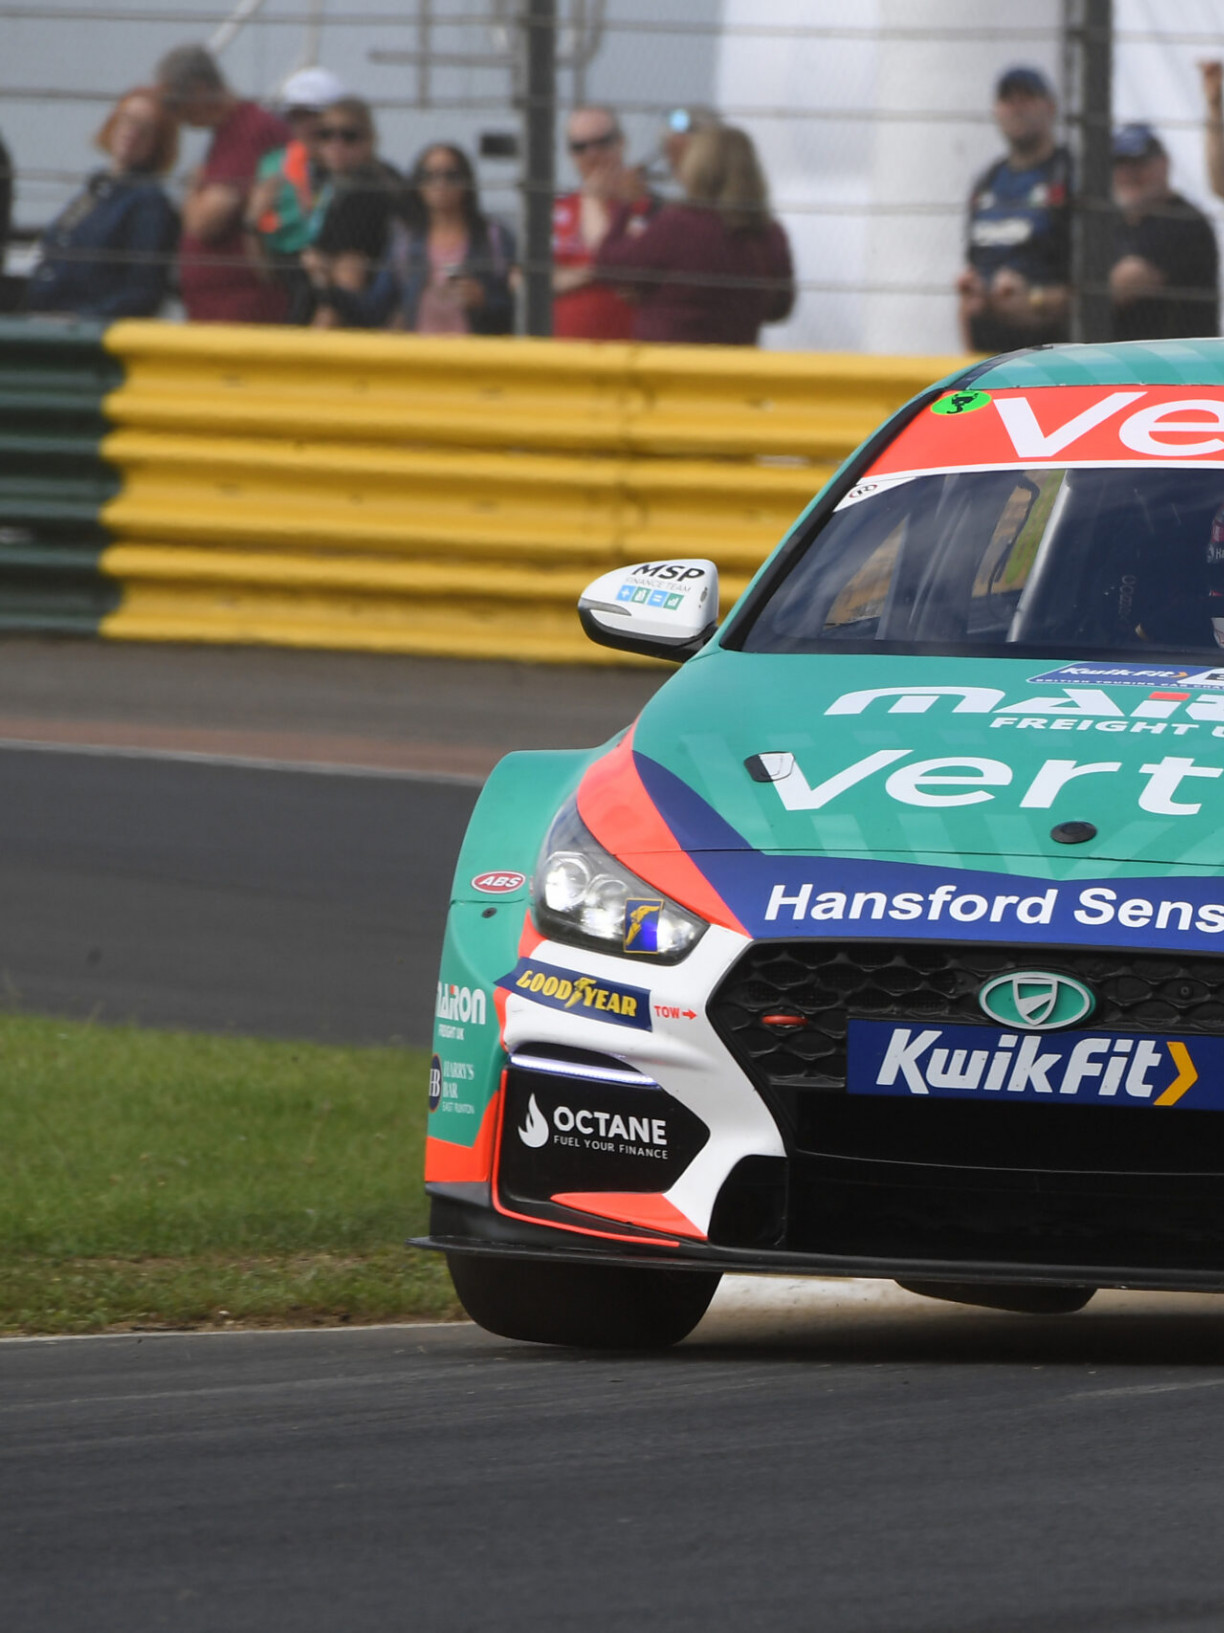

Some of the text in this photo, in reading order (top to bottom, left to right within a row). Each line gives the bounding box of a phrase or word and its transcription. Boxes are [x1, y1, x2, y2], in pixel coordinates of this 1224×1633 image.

[632, 564, 706, 582] MSP
[626, 578, 691, 593] FINANCE TEAM
[990, 717, 1200, 736] FREIGHT
[480, 875, 521, 888] ABS
[764, 884, 1061, 924] Hansford
[654, 1005, 680, 1019] TOW
[443, 1081, 458, 1099] BAR
[553, 1105, 667, 1146] OCTANE
[553, 1135, 668, 1160] FUEL YOUR FINANCE
